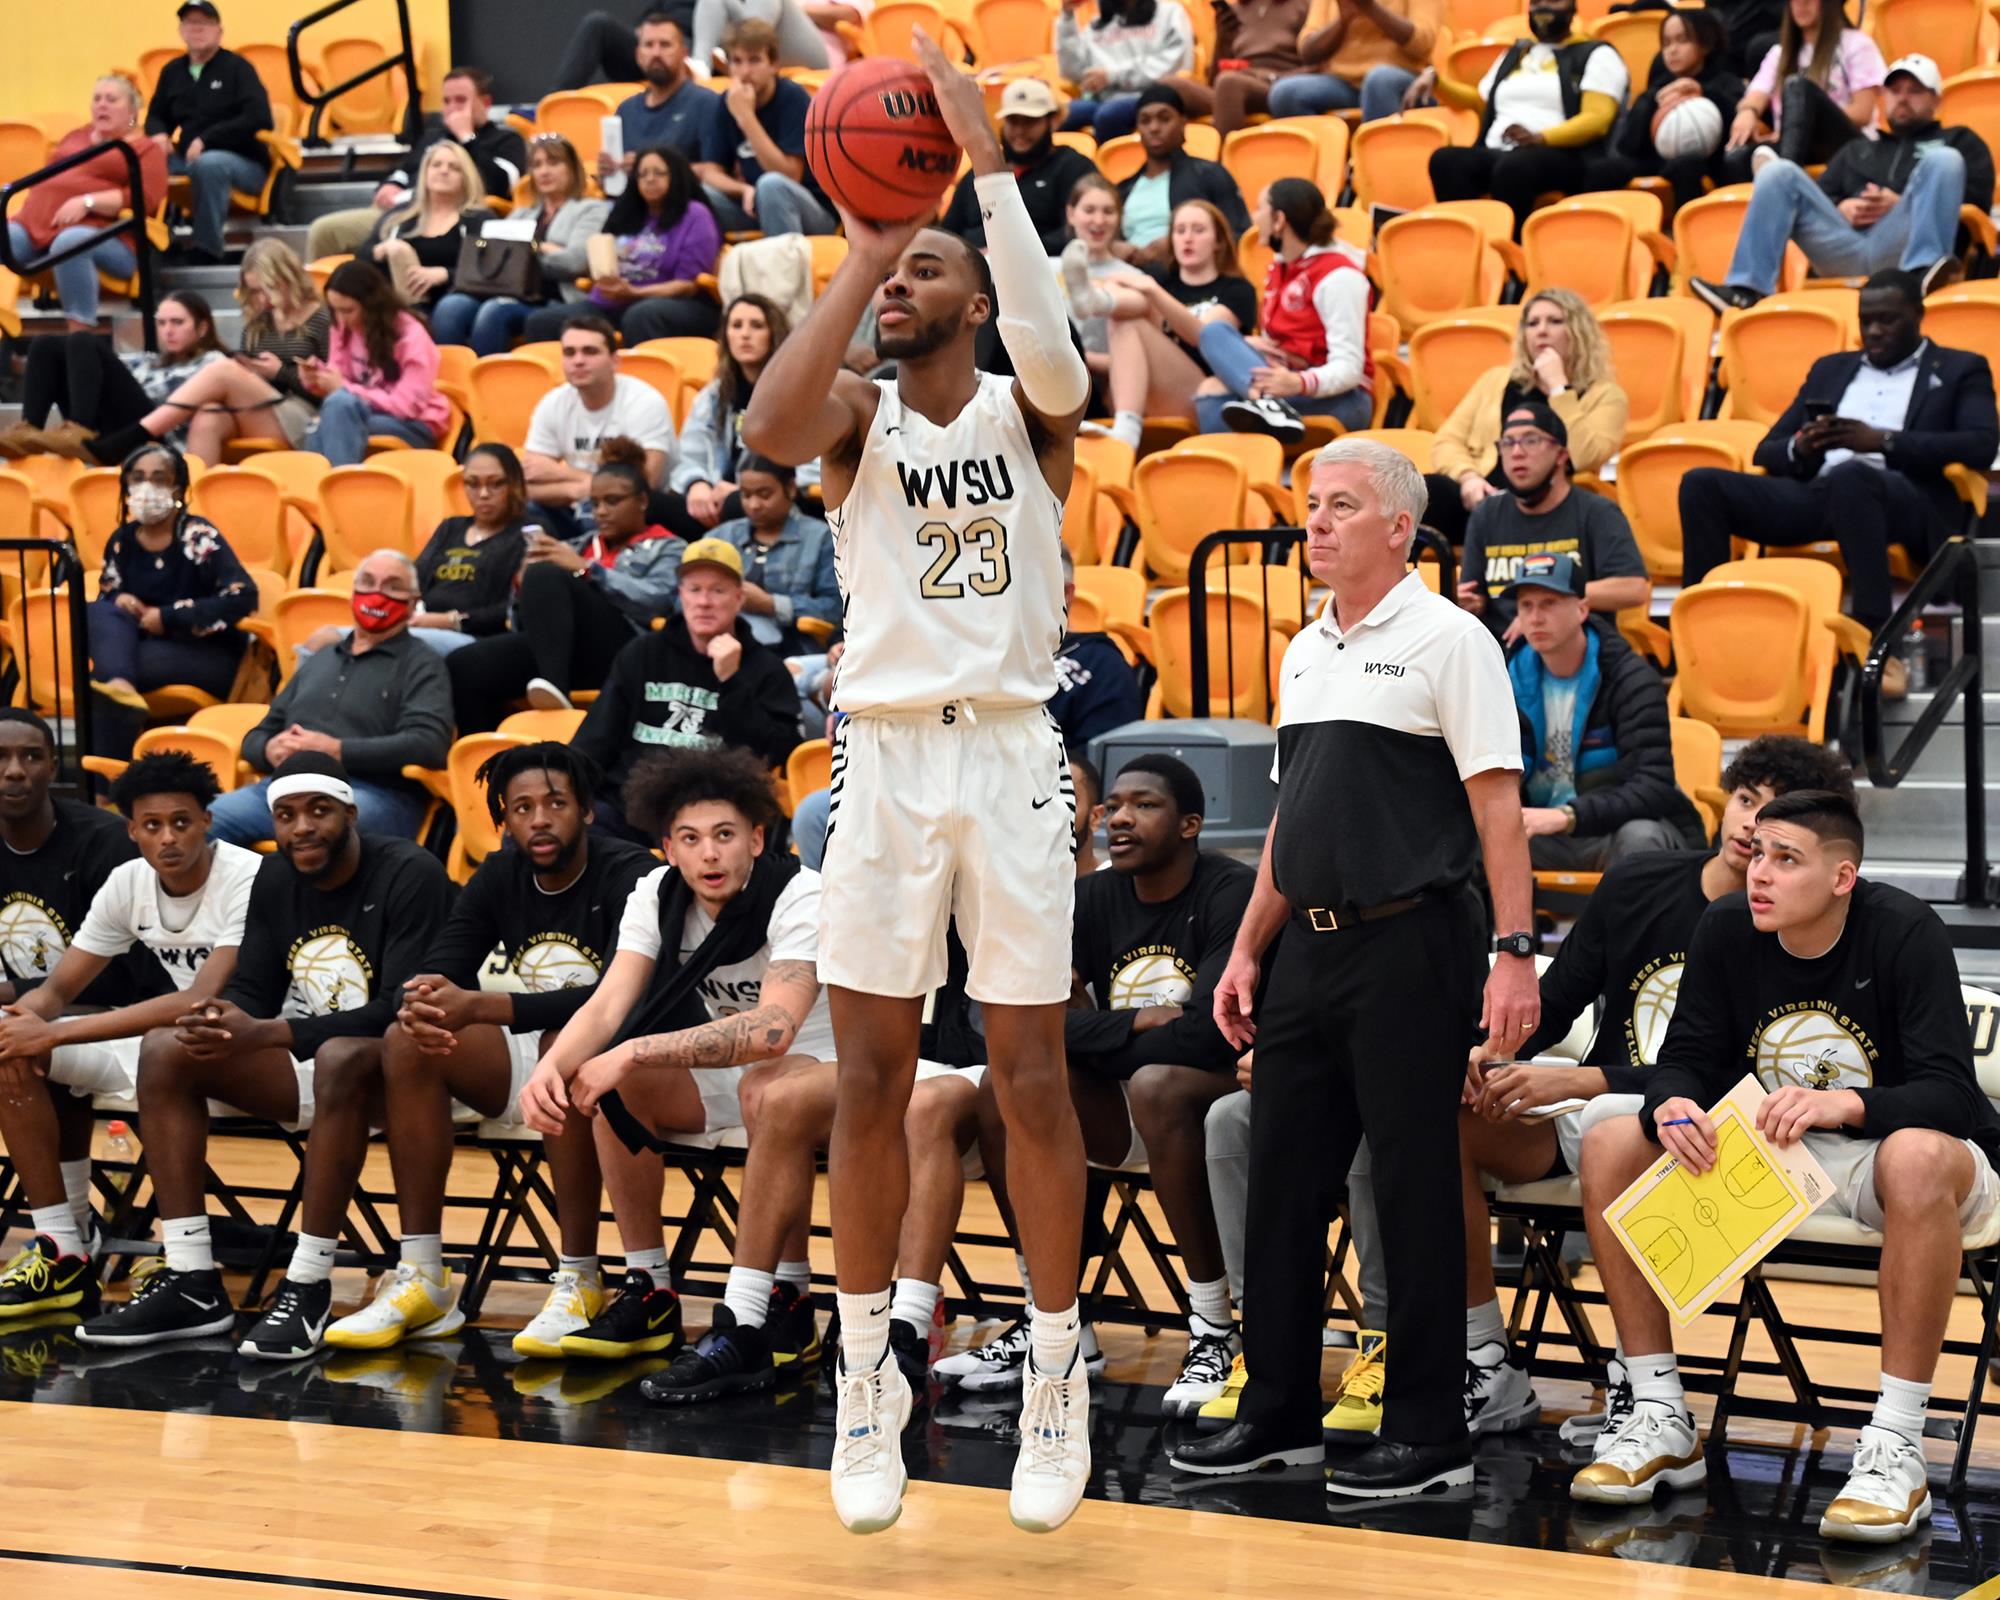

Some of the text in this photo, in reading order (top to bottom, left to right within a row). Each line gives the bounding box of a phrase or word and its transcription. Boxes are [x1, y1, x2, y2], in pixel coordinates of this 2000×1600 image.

[897, 454, 1014, 509] WVSU
[917, 516, 1012, 599] 23
[1364, 662, 1406, 678] WVSU
[942, 704, 956, 725] S
[347, 940, 374, 979] STATE
[1629, 957, 1661, 991] WEST
[1746, 999, 1880, 1061] WEST VIRGINIA STATE
